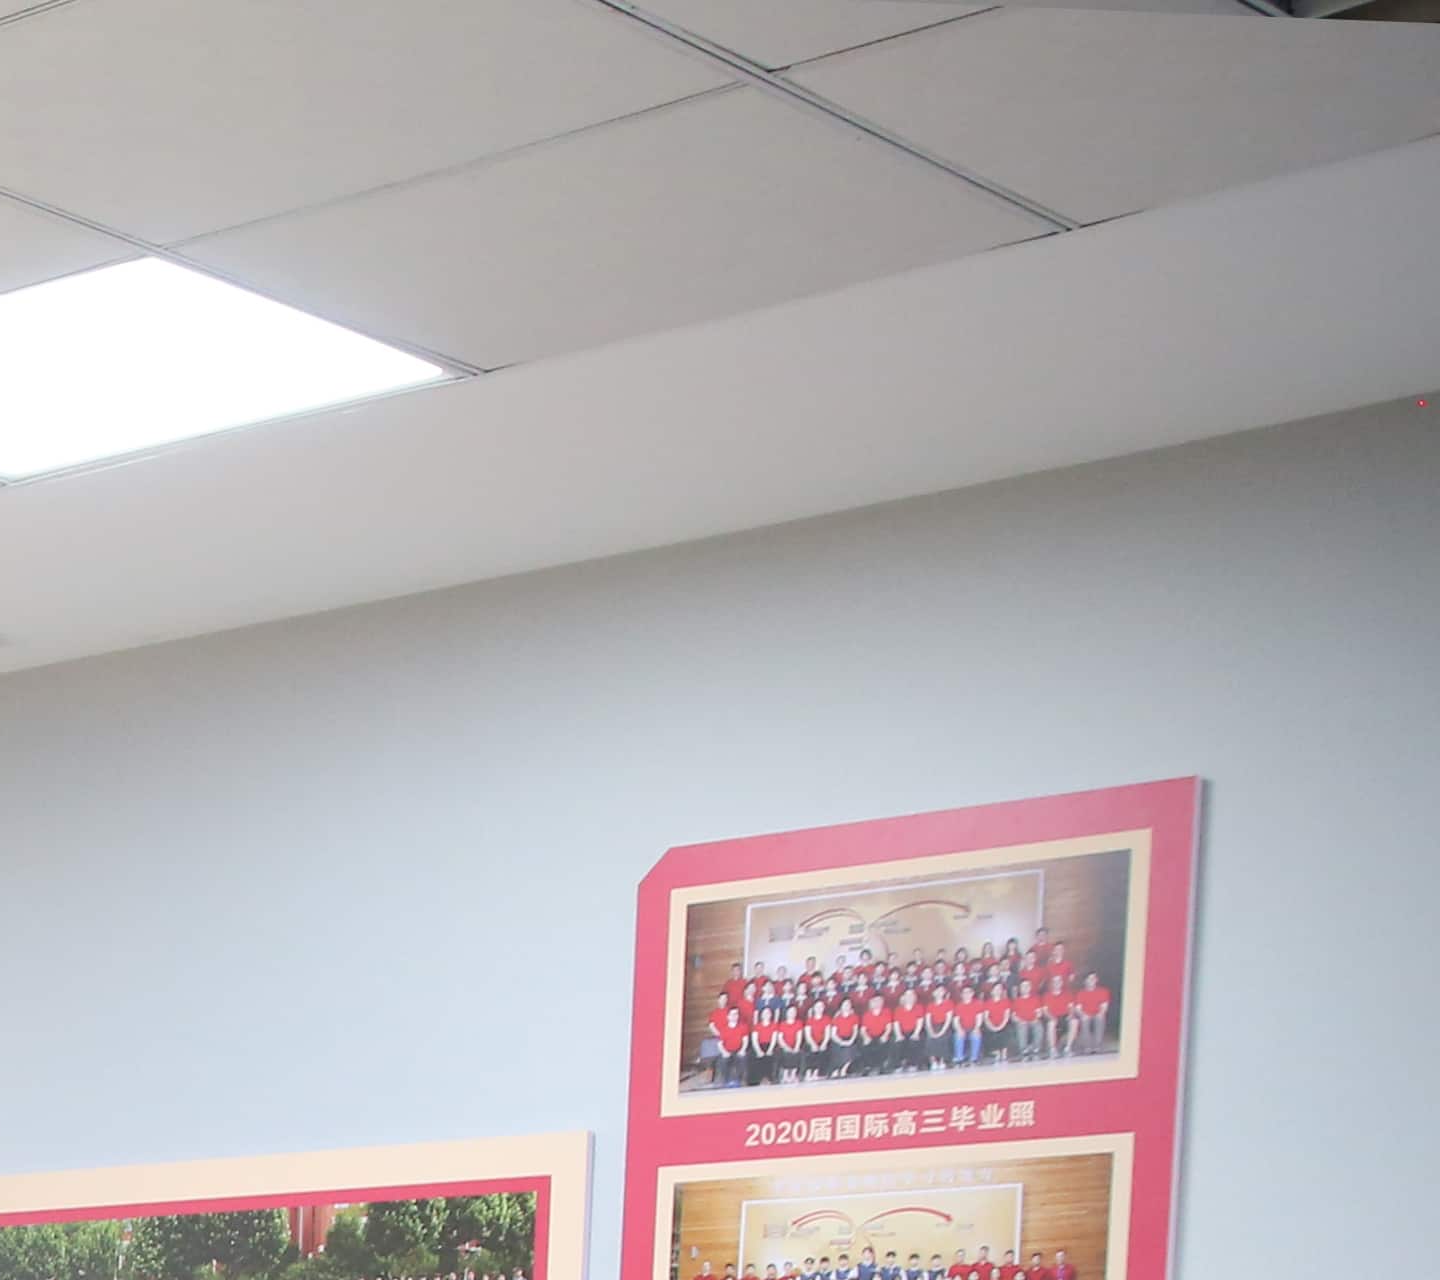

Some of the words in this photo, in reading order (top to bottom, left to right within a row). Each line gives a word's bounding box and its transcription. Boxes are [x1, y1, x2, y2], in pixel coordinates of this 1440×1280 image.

[746, 1101, 1036, 1148] 2020届国际高三毕业照
